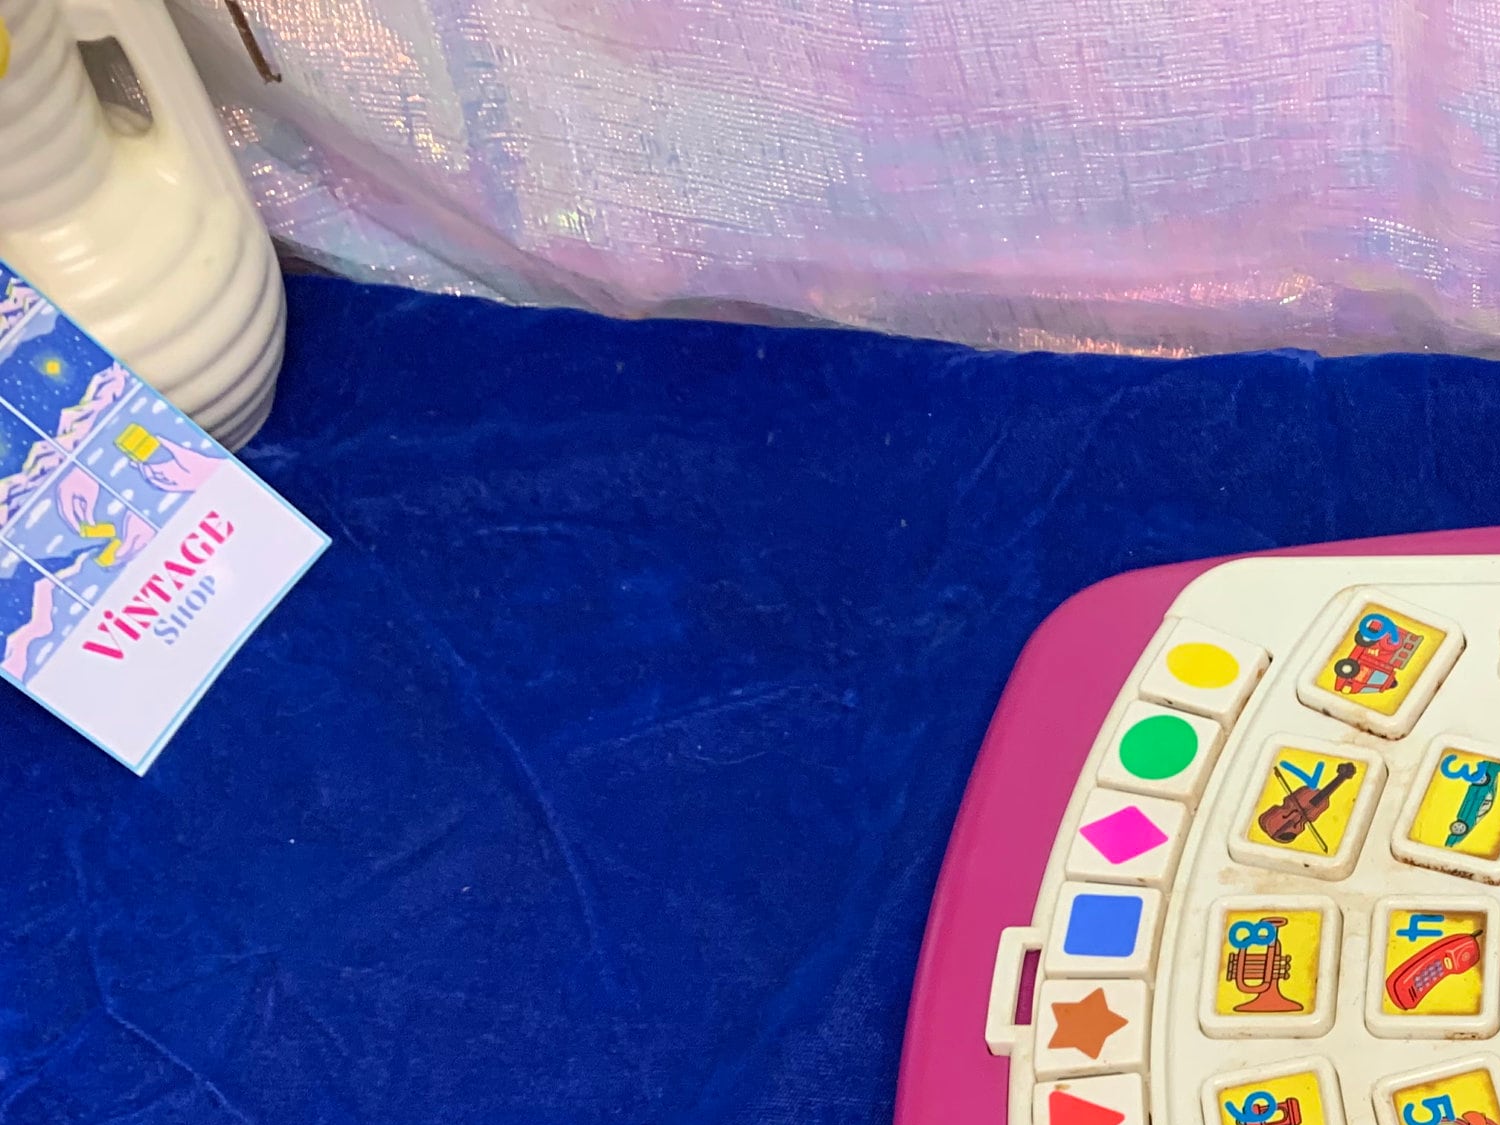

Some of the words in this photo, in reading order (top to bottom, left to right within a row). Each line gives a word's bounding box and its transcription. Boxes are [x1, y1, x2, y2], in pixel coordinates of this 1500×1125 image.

[152, 573, 218, 645] SHOP
[1359, 613, 1399, 644] 6
[1280, 760, 1325, 790] 7
[1440, 754, 1486, 783] 3
[1228, 921, 1277, 949] 8
[1396, 915, 1444, 942] 4
[1225, 1090, 1277, 1124] 9
